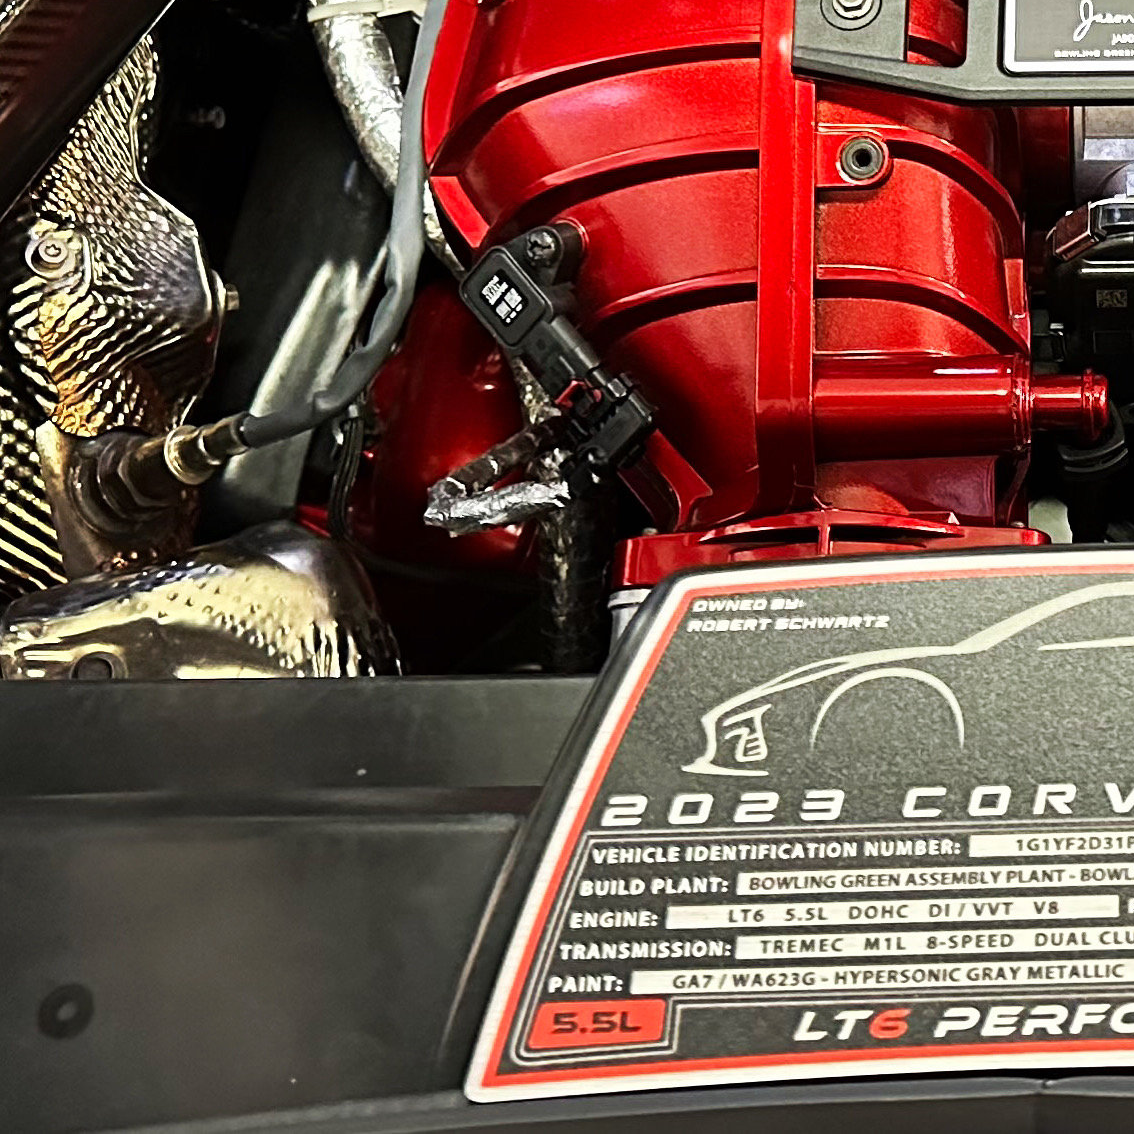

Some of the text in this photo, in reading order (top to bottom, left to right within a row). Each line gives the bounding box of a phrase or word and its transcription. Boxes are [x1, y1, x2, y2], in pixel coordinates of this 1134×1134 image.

[692, 599, 767, 612] OWNED
[687, 615, 890, 632] ROBERT SCHWARTZ
[601, 789, 845, 826] 2023
[592, 846, 680, 865] VEHICLE
[686, 842, 857, 863] IDENTIFICATION
[864, 840, 961, 859] NUMBER:
[579, 879, 645, 897] BUILD
[651, 876, 728, 895] PLANT:
[749, 874, 836, 891] BOWLING
[841, 873, 900, 888] GREEN
[905, 869, 1002, 887] ASSEMBLY
[1006, 869, 1065, 884] PLANT
[569, 911, 658, 929] ENGINE:
[728, 908, 765, 924] LT6
[784, 906, 828, 922] 5.5L
[849, 904, 909, 920] DOHC
[928, 903, 951, 918] DI
[972, 901, 1015, 916] VVT
[1034, 900, 1059, 914] V8
[559, 940, 731, 960] TRANSMISSION:
[760, 938, 844, 954] TREMEC
[863, 936, 906, 951] M1L
[926, 933, 1015, 949] 8-SPEED
[1034, 931, 1091, 947] DUAL
[548, 976, 623, 994] PAINT:
[673, 974, 713, 990] GA7
[732, 971, 816, 987] WA623G
[834, 967, 963, 986] HYPERSONIC
[966, 966, 1020, 983] GRAY
[1027, 963, 1125, 981] METALLIC
[552, 1012, 641, 1034] 5.5L
[793, 1008, 912, 1041] LT6
